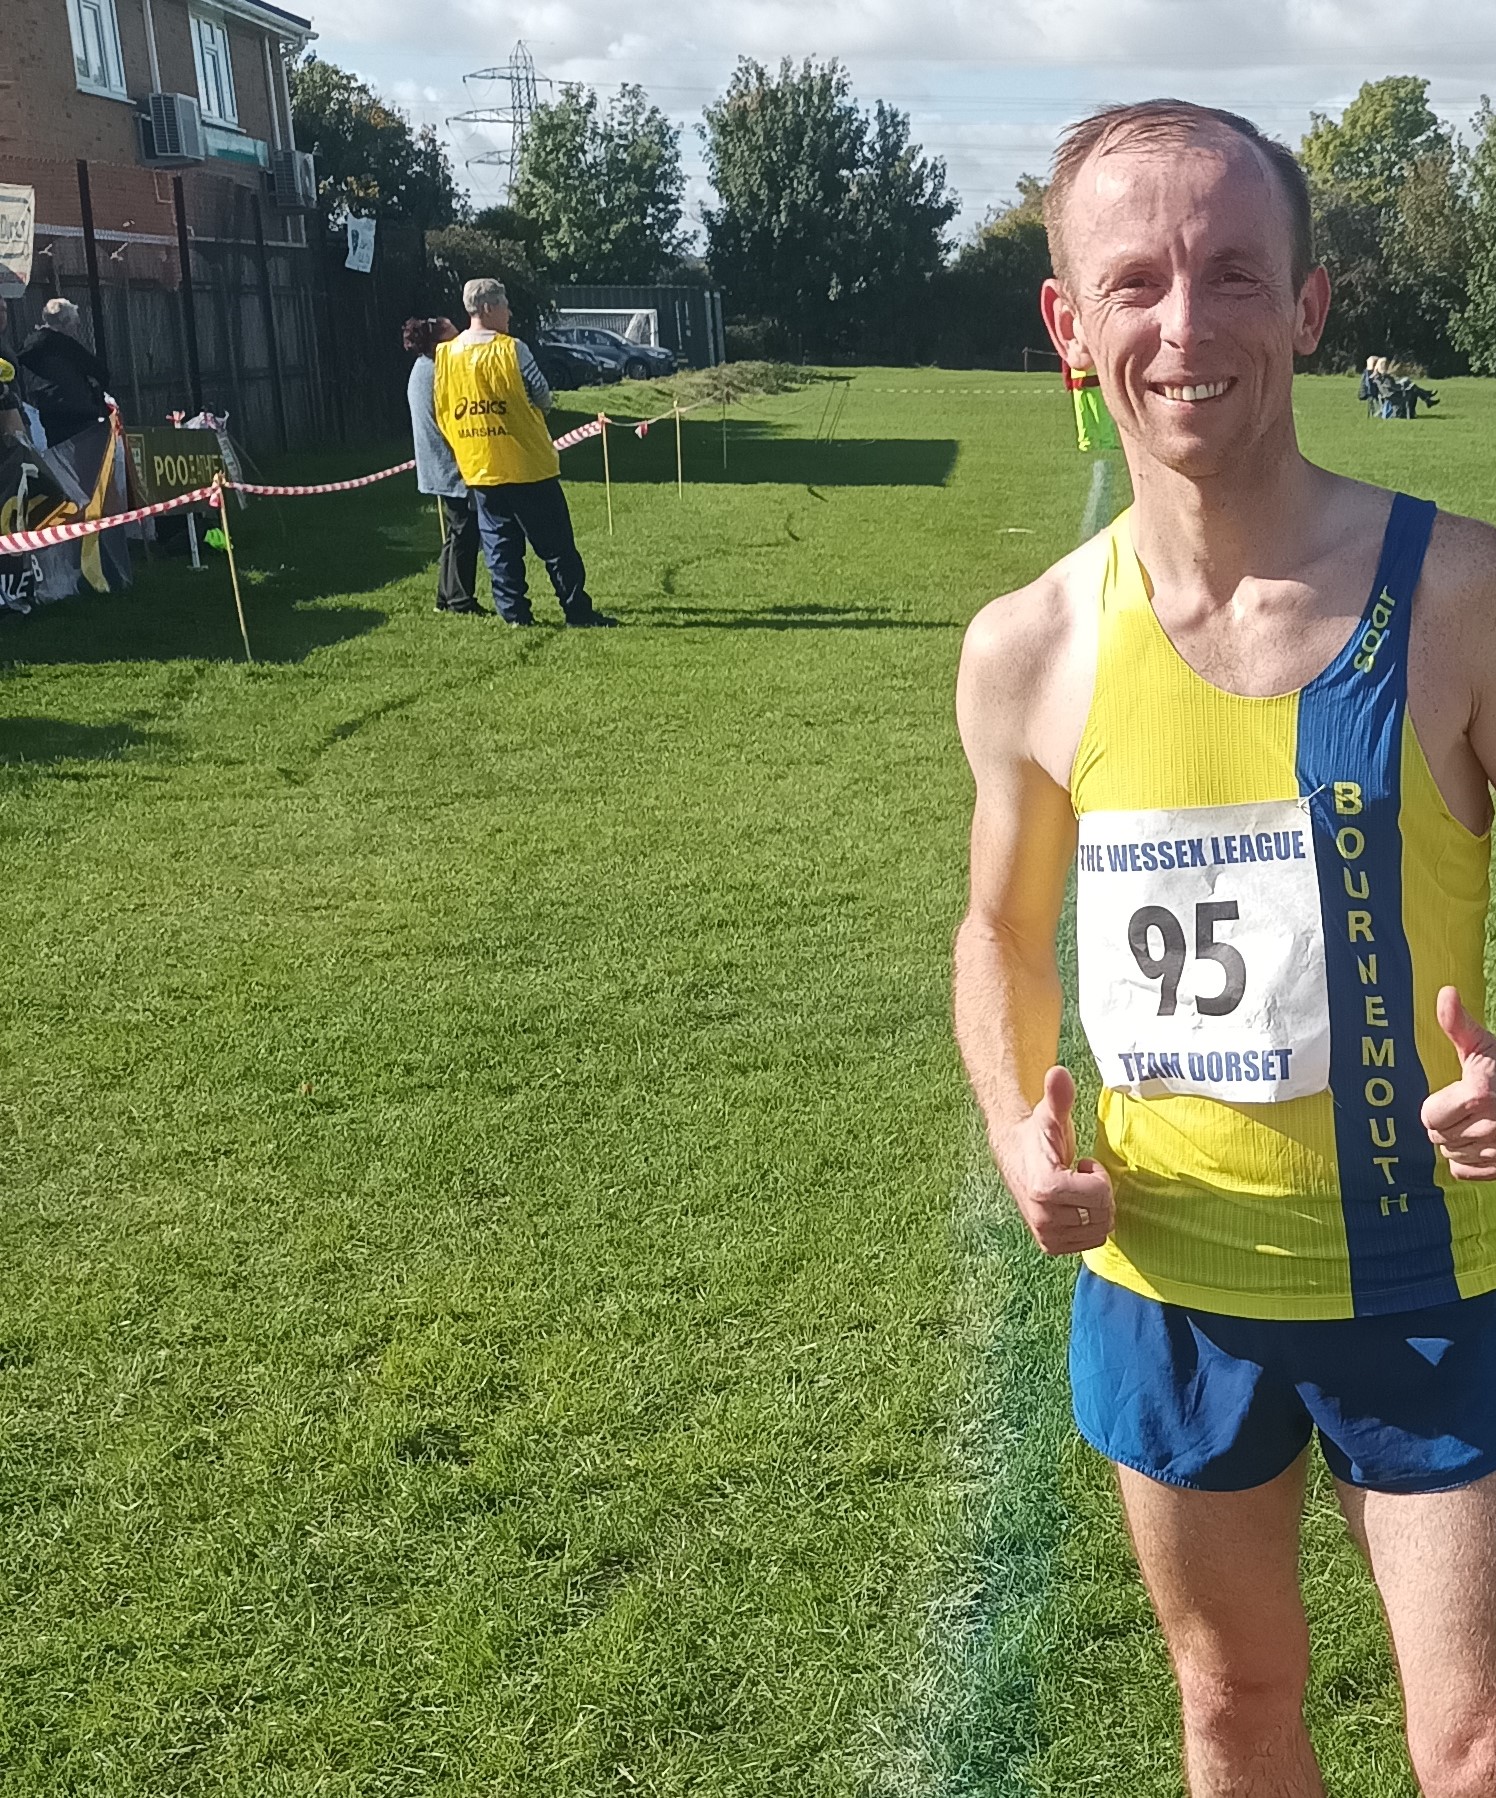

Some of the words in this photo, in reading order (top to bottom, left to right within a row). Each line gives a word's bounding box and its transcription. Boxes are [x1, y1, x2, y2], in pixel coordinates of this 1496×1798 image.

[469, 399, 508, 417] asics
[457, 425, 509, 438] MARSHA
[1353, 584, 1396, 674] soar
[1080, 844, 1105, 873] THE
[1107, 837, 1208, 873] WESSEX
[1211, 830, 1307, 866] LEAGUE
[1127, 900, 1247, 1017] 95
[1333, 781, 1409, 1216] BOURNEMOUTH
[1118, 1051, 1186, 1083] TEAM
[1187, 1047, 1294, 1084] DORSET
